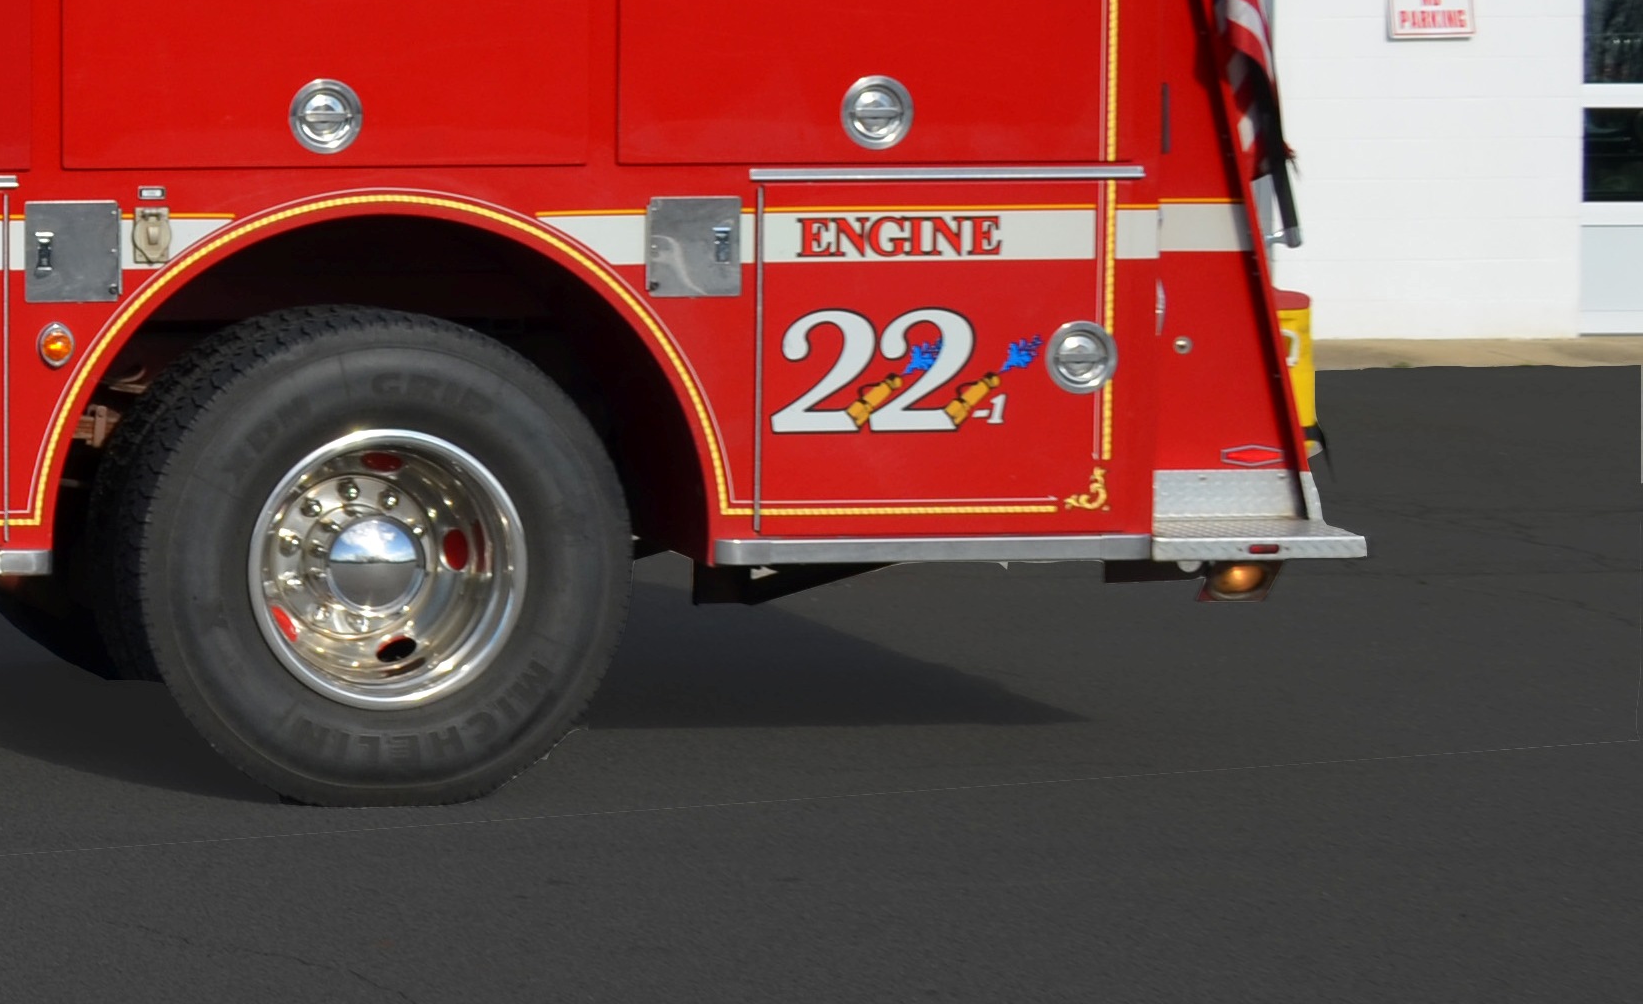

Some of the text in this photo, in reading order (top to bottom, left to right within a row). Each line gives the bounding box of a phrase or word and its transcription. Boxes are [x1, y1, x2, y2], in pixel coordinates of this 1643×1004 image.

[1399, 9, 1467, 29] PARKING
[797, 215, 1003, 258] ENGINE
[370, 370, 499, 417] GRIP
[770, 307, 976, 434] 22
[290, 656, 557, 761] MICHELIN
